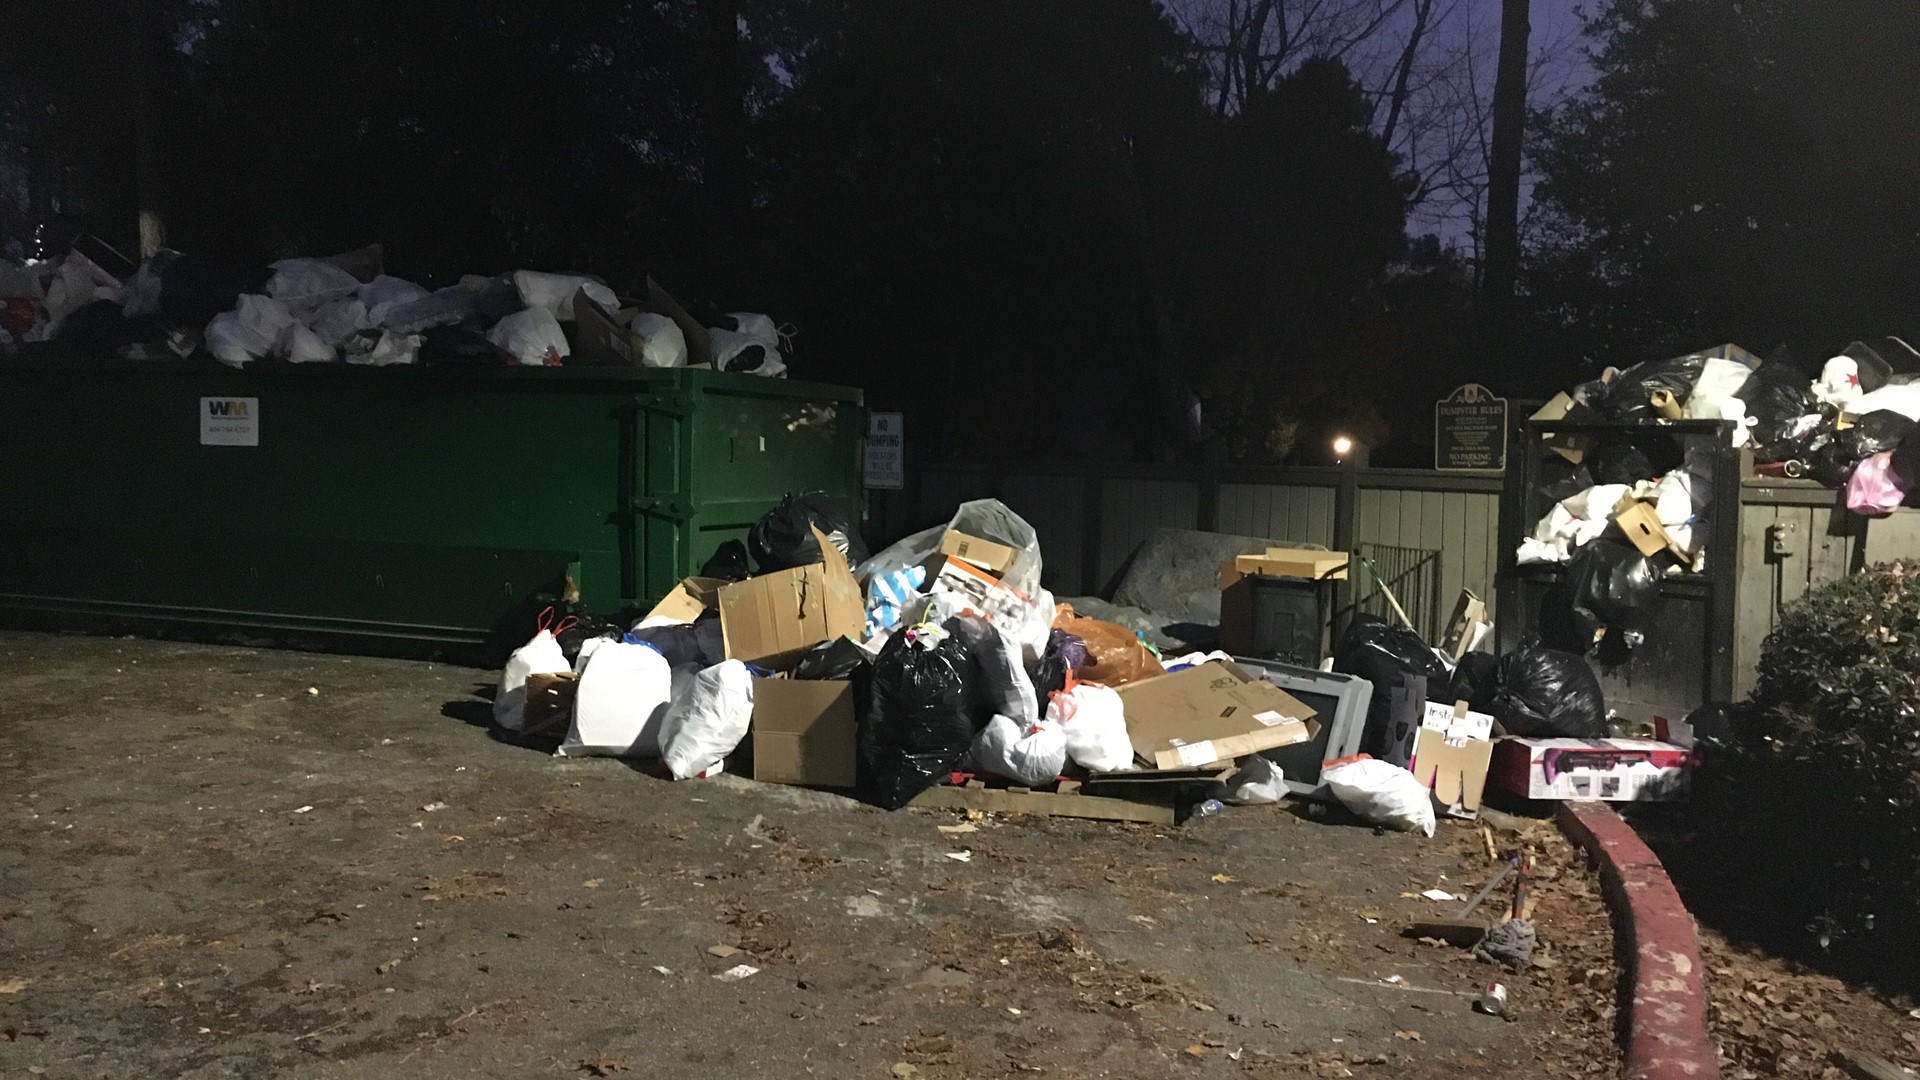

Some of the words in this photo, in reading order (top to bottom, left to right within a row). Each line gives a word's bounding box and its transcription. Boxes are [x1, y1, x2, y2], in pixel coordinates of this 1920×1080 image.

[209, 401, 248, 415] WM
[1441, 407, 1477, 415] DUMPSTER
[1480, 406, 1503, 415] RULES
[877, 419, 888, 431] NO
[866, 434, 899, 447] DUMPING
[1461, 453, 1491, 461] PARKING
